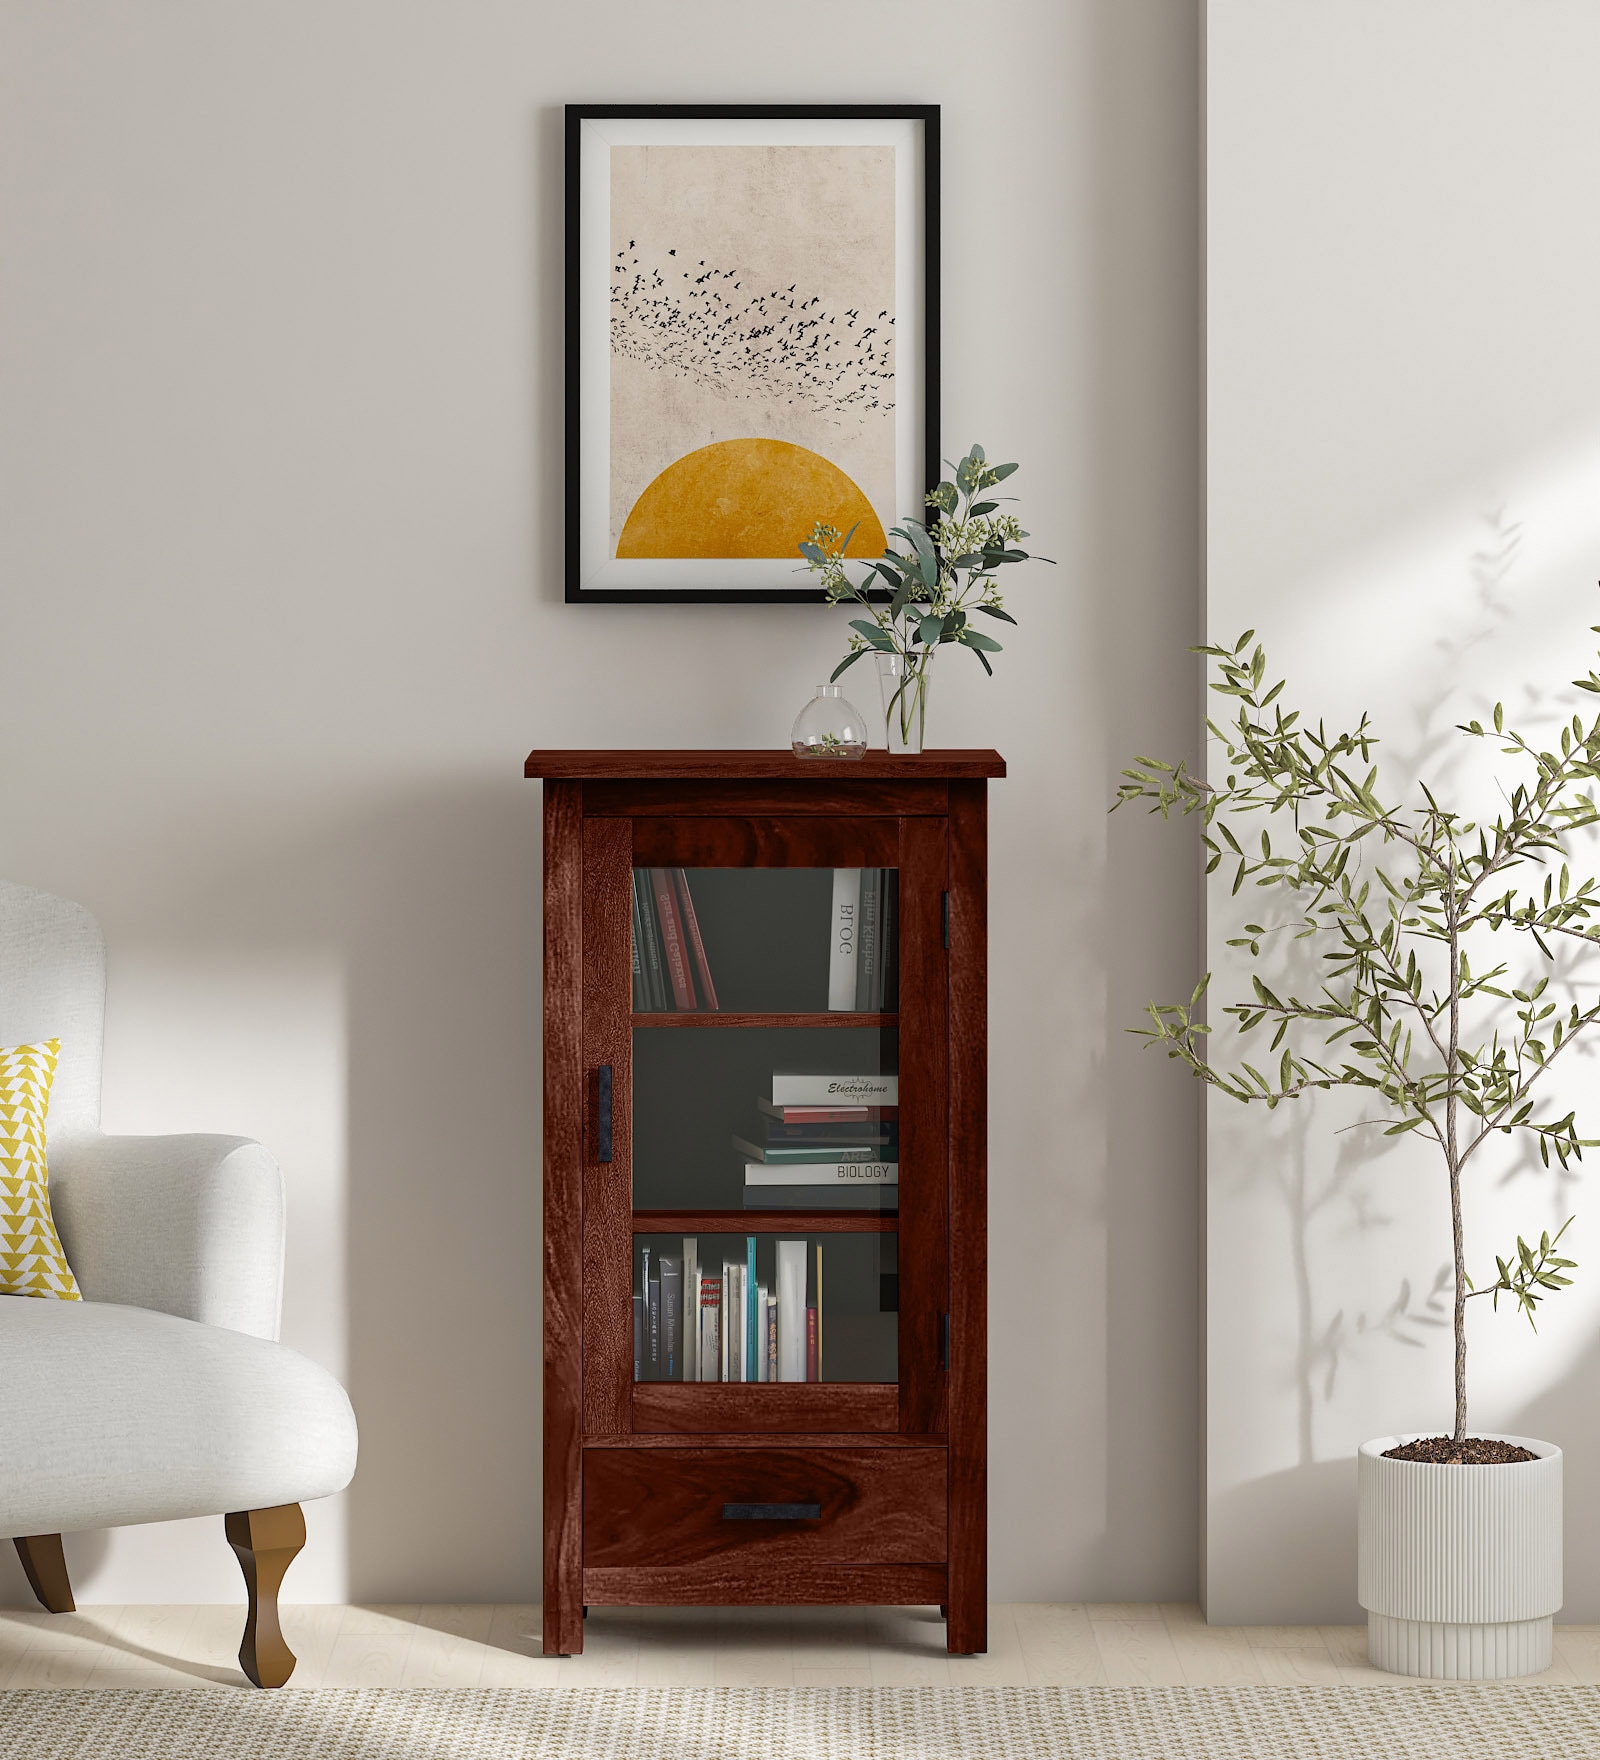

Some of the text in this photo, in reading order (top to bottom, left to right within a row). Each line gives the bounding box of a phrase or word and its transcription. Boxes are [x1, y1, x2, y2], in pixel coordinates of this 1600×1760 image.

[828, 1082, 888, 1094] Electrohome
[841, 1151, 879, 1162] AREA
[837, 1165, 889, 1178] BIOLOGY
[667, 1293, 675, 1317] Susan
